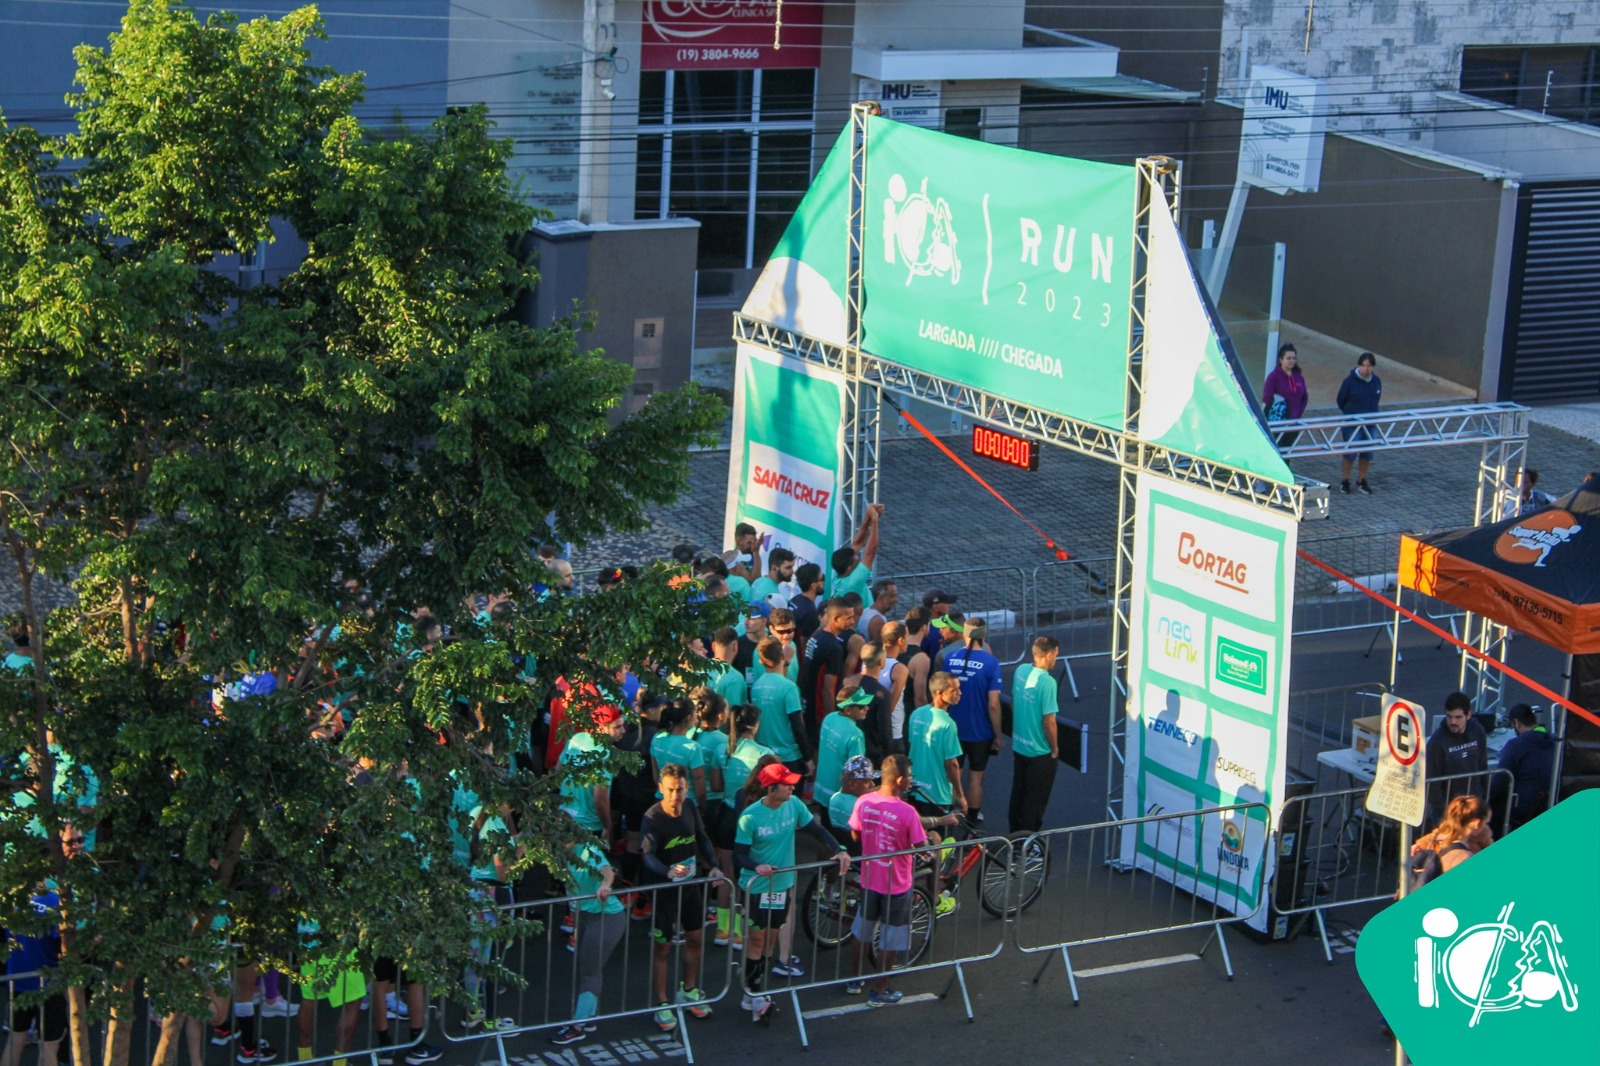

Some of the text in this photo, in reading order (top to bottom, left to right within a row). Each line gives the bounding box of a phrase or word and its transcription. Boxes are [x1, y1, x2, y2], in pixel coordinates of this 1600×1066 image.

[677, 48, 759, 61] (19) 3804-9666
[882, 84, 910, 99] IMU
[1265, 86, 1288, 110] IMU
[1020, 218, 1113, 284] RUN
[1018, 282, 1111, 327] 2023
[918, 319, 976, 352] LARGADA
[1001, 344, 1063, 378] CHEGADA
[974, 427, 1029, 467] 00:00:00
[1514, 596, 1563, 624] 97135-5715
[949, 658, 984, 669] TENECO
[1149, 716, 1198, 746] TENNECO
[1398, 714, 1409, 753] E
